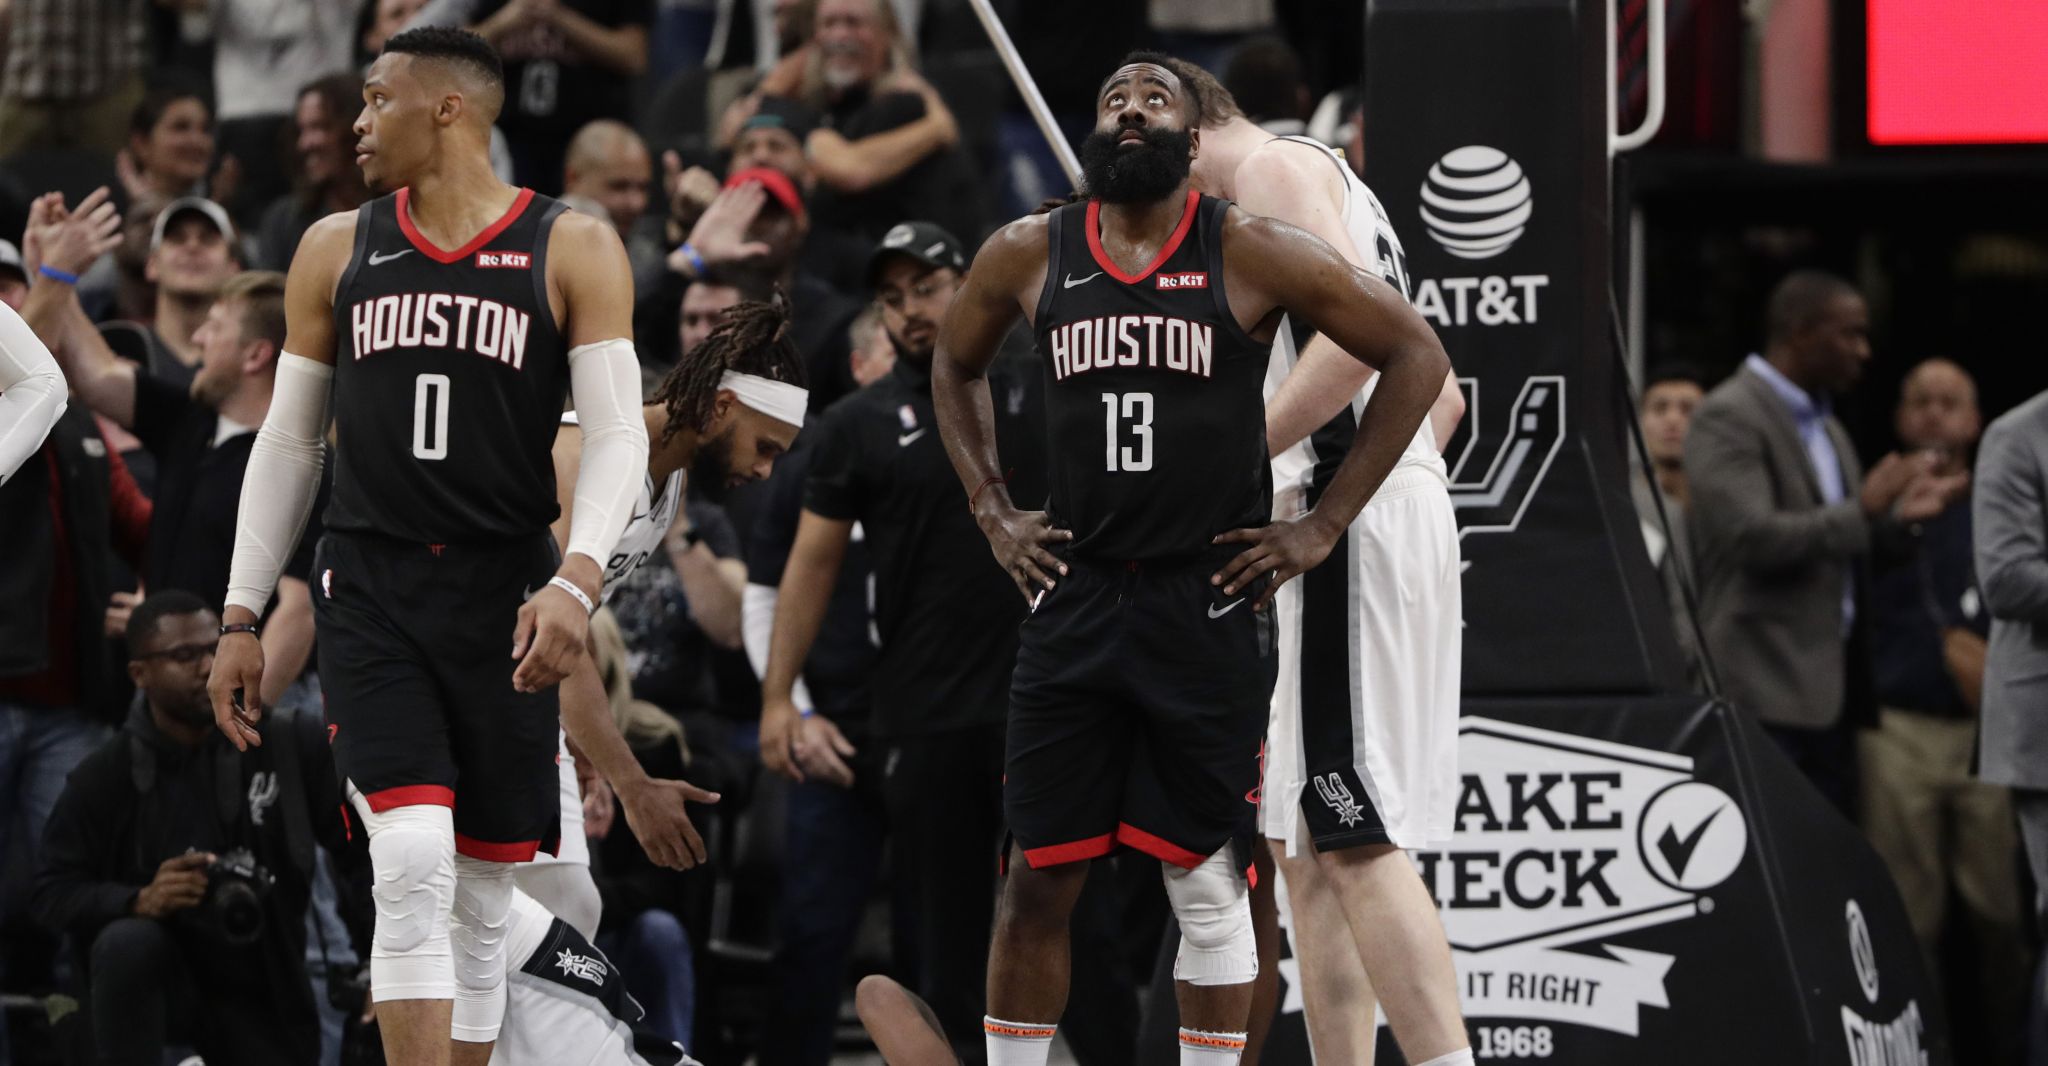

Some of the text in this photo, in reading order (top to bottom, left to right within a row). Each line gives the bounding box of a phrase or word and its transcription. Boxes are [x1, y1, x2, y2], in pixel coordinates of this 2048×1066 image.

[352, 292, 530, 371] HOUSTON
[1413, 275, 1549, 327] AT&T
[1050, 315, 1213, 381] HOUSTON
[412, 373, 450, 461] 0
[1102, 392, 1154, 472] 13
[1454, 772, 1622, 832] AKE
[1468, 972, 1601, 1006] IT RIGHT
[1477, 1025, 1554, 1059] 1968
